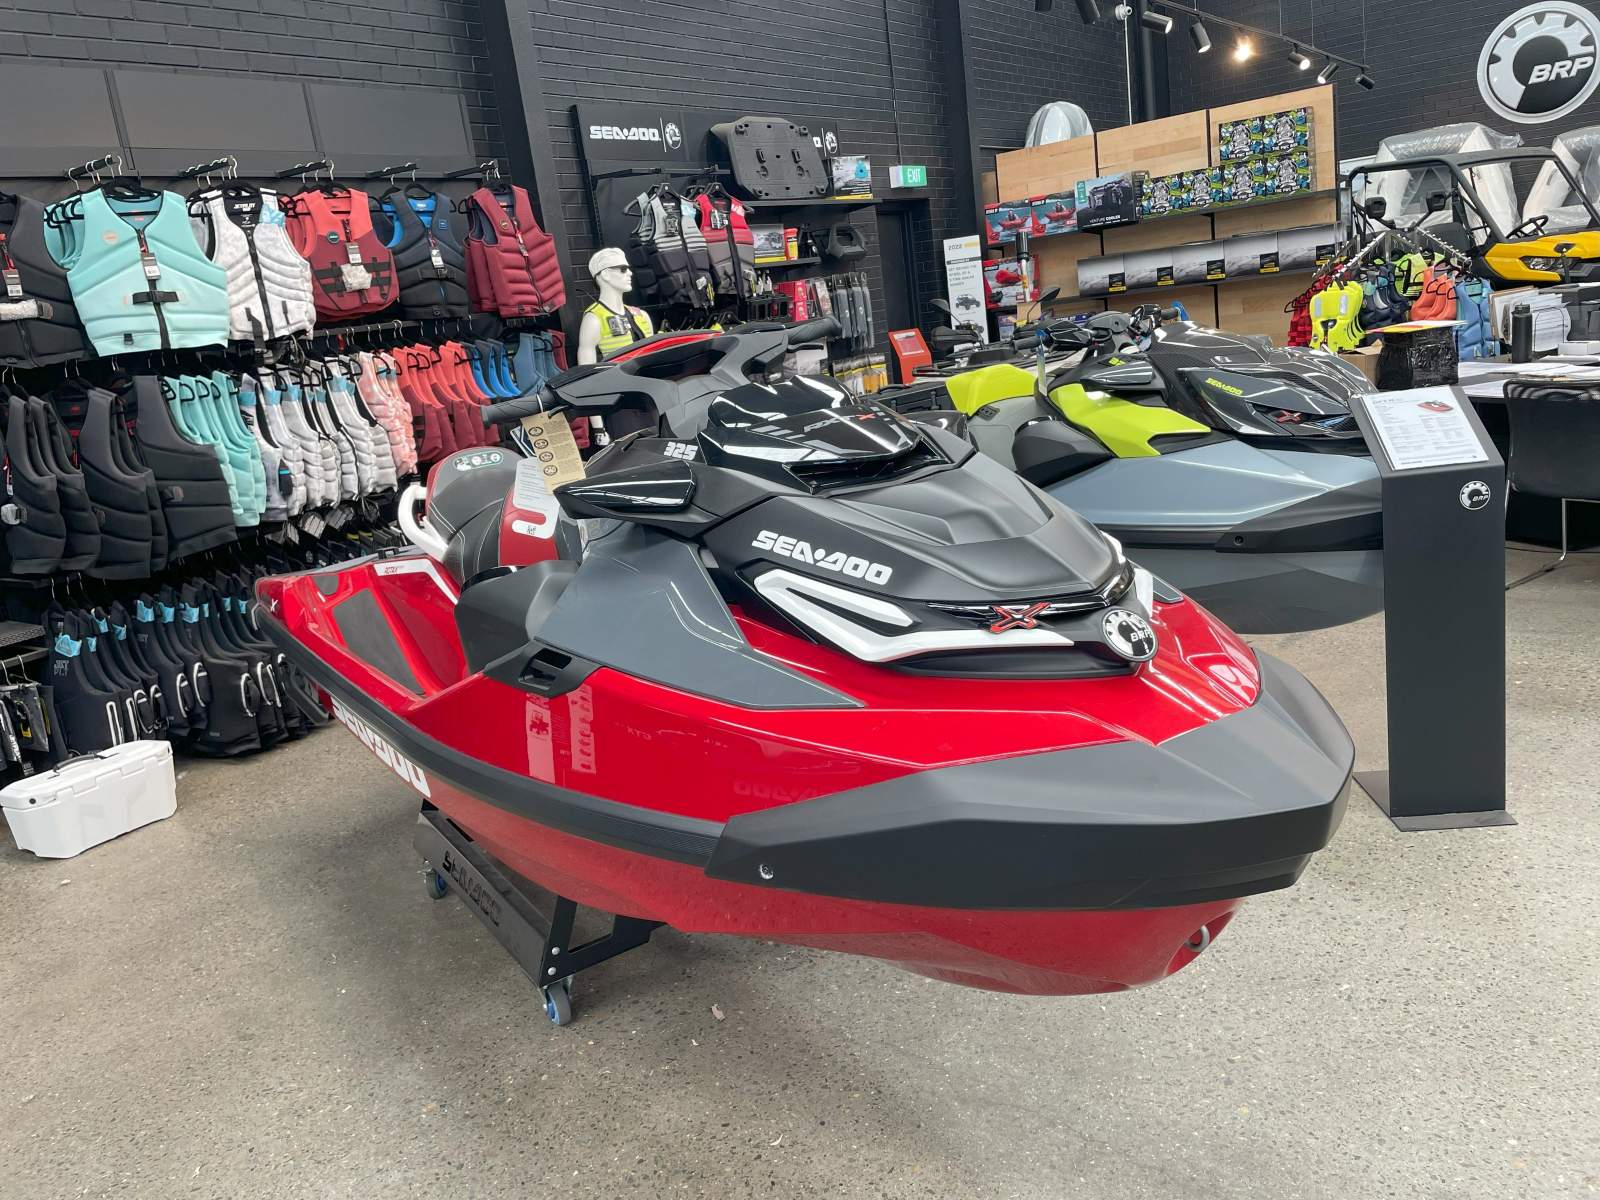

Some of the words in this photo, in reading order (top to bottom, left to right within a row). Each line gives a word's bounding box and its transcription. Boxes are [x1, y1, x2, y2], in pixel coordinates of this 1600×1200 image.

[1528, 56, 1595, 85] BRP
[907, 168, 922, 183] EXIT
[663, 441, 699, 461] 325
[1472, 494, 1489, 502] BRP
[1130, 629, 1153, 642] BRP
